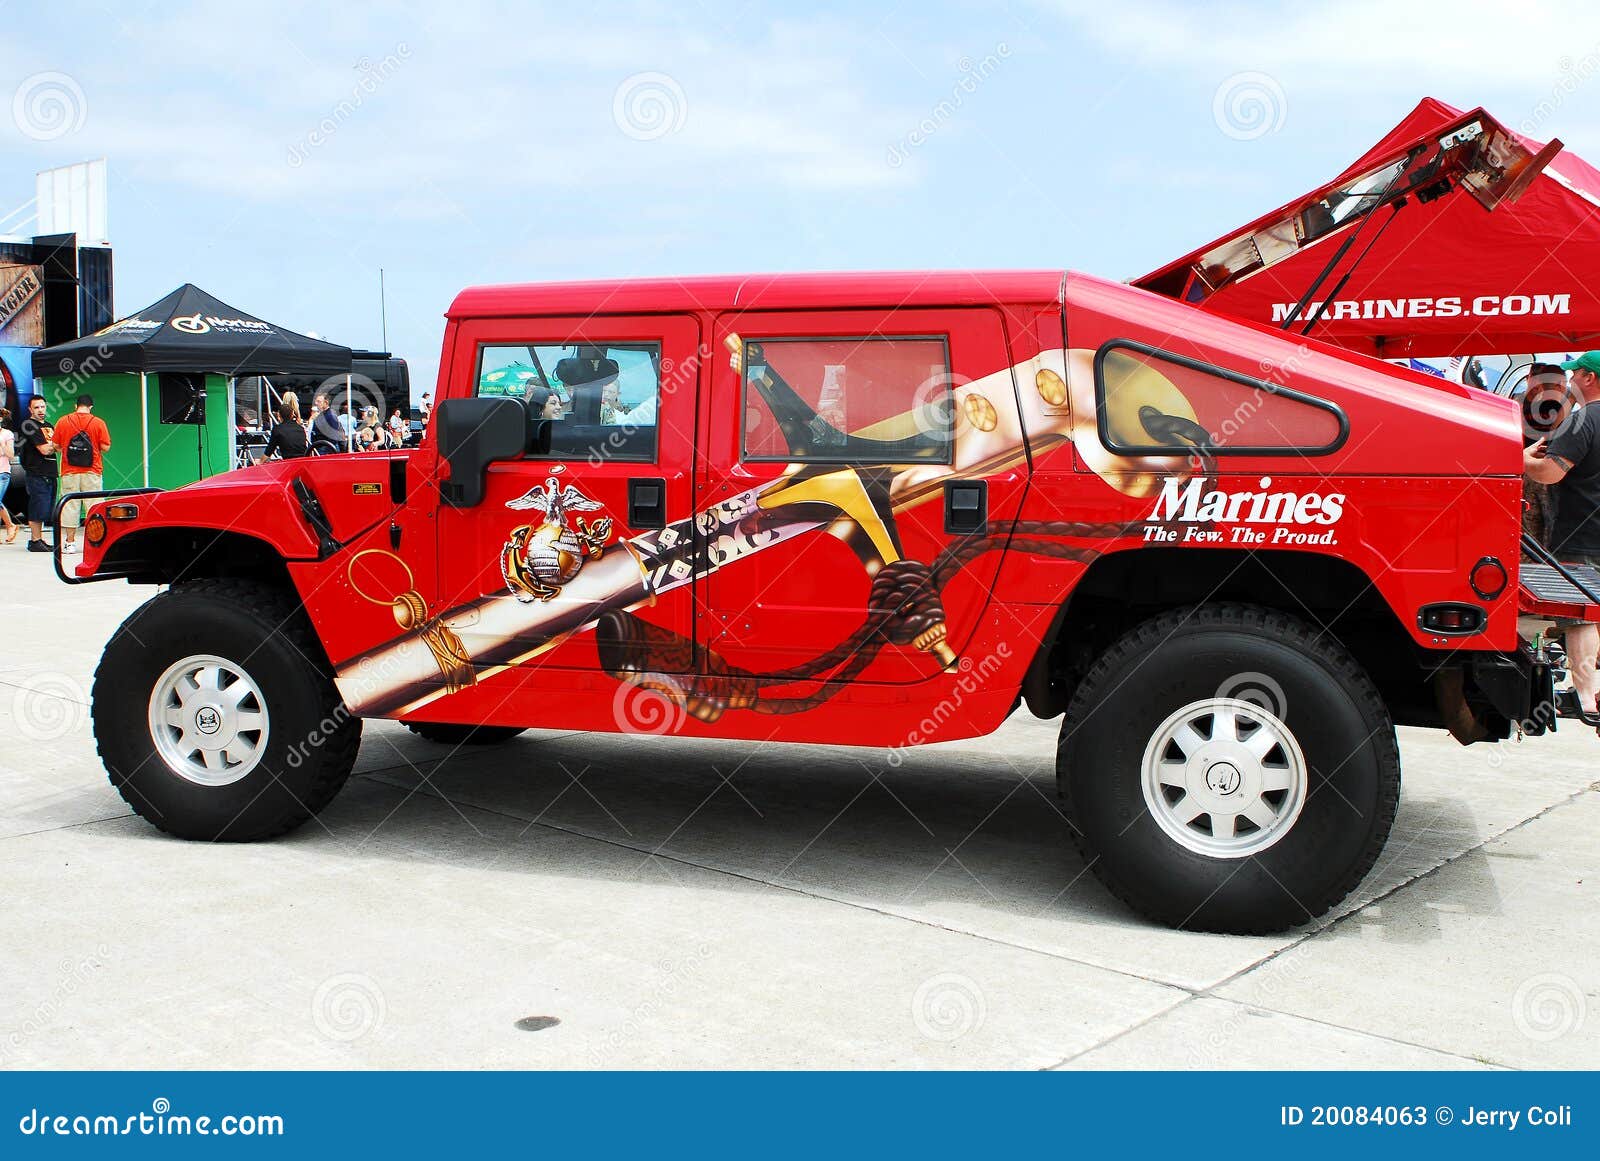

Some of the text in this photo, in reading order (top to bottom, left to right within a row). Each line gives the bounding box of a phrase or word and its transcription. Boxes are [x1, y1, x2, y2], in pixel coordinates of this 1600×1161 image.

[0, 277, 36, 321] NGER
[1271, 294, 1571, 322] MARINES.COM
[205, 316, 271, 330] Norton
[1146, 476, 1346, 525] Marines
[1142, 526, 1339, 546] The Few. The Proud.
